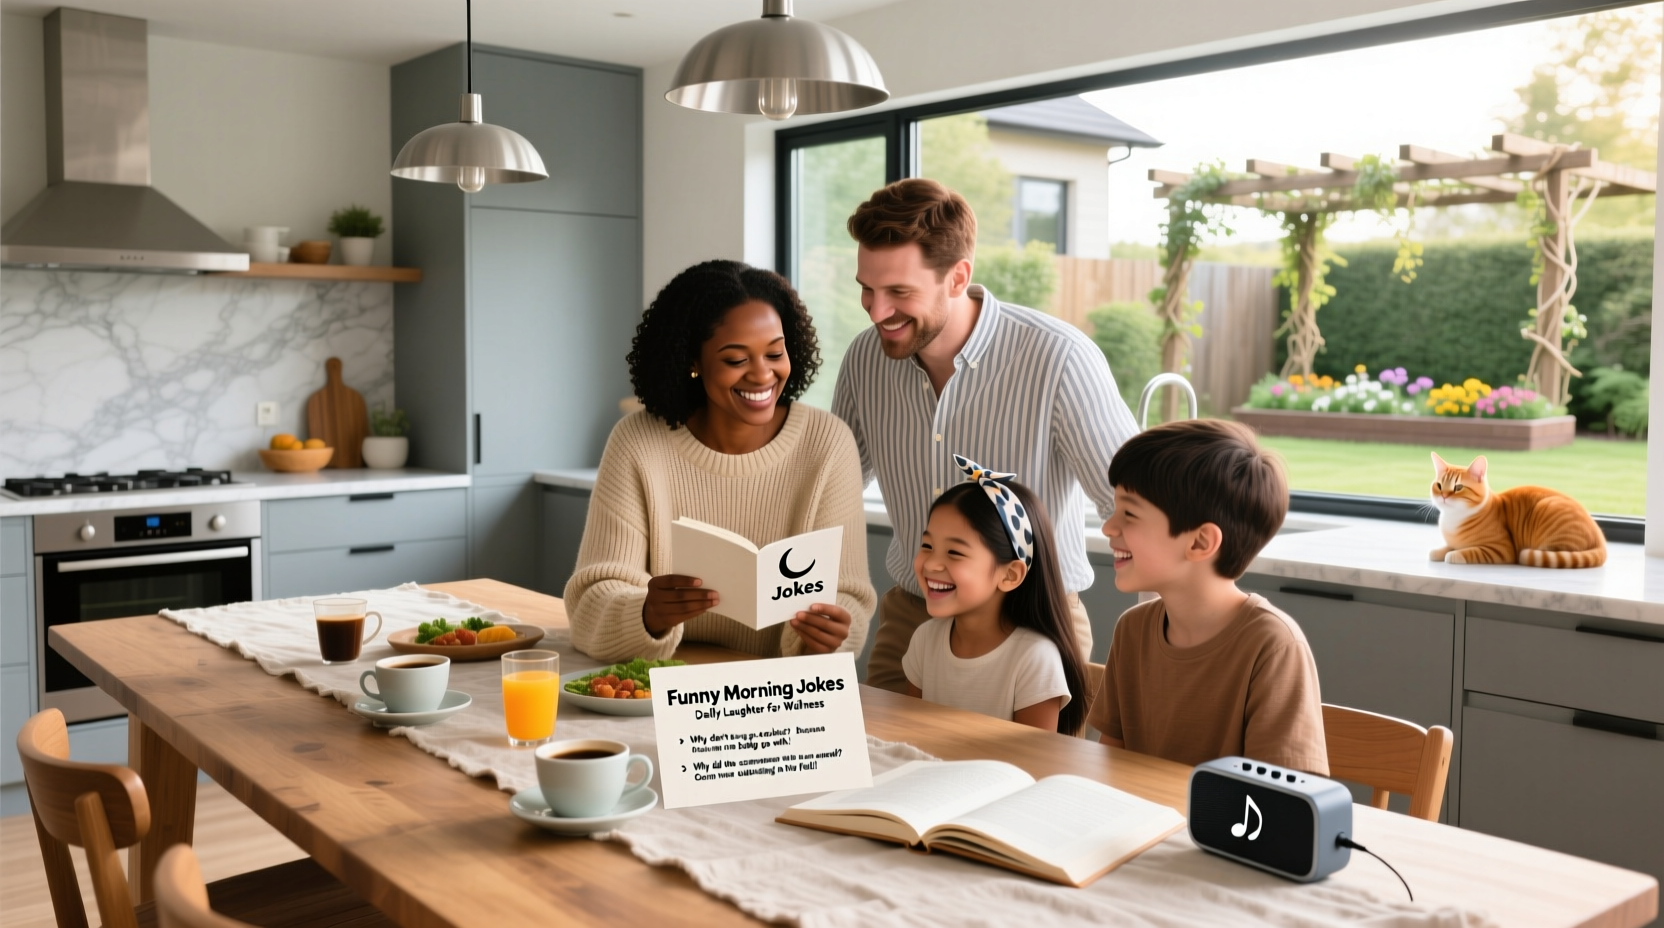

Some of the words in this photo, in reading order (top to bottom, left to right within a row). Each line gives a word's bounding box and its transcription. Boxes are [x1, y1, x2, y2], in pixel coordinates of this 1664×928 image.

[771, 580, 824, 601] Jokes
[667, 690, 720, 706] Funny
[723, 681, 793, 702] Morning
[796, 676, 845, 694] Jokes
[690, 734, 707, 746] Why
[693, 761, 709, 773] Why
